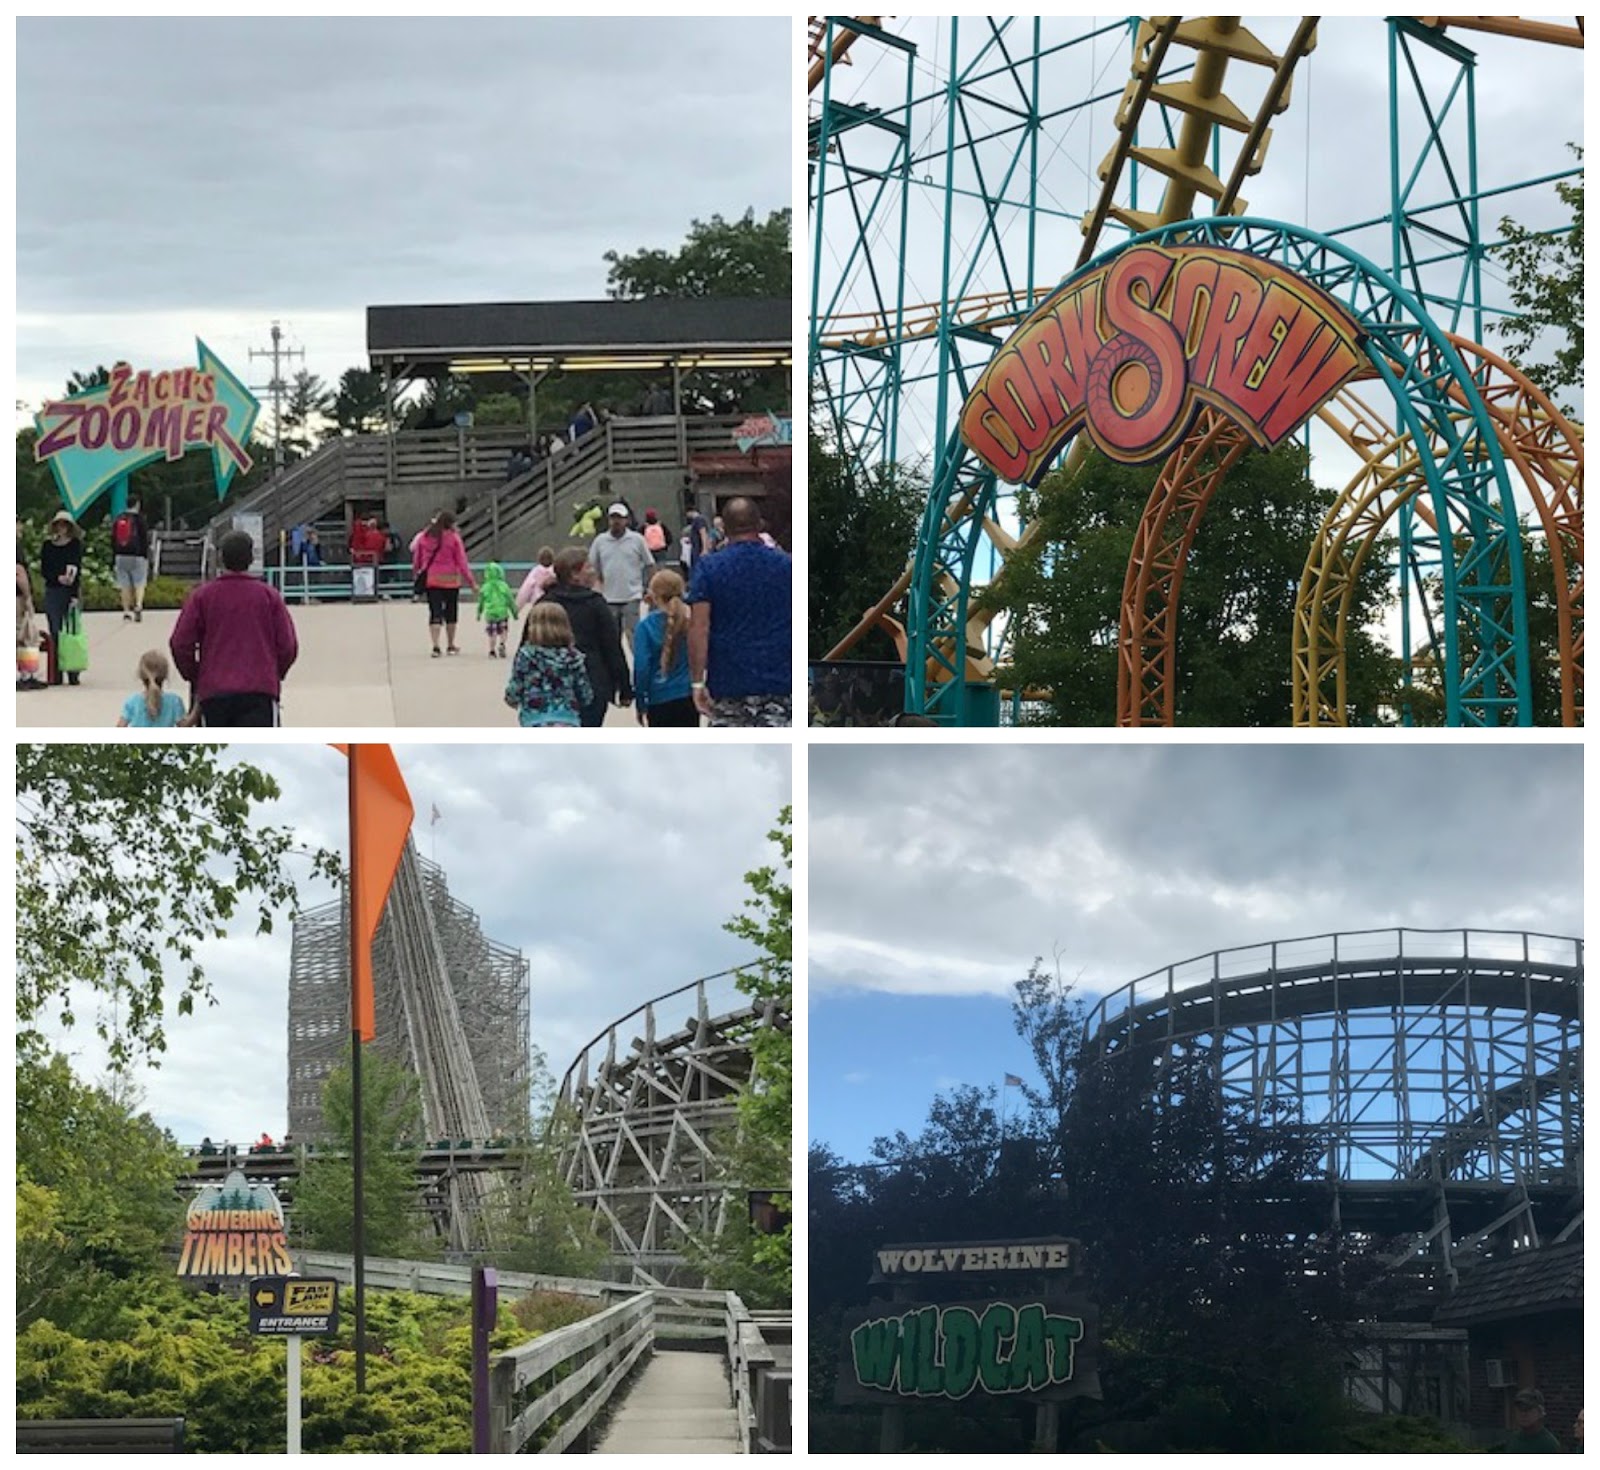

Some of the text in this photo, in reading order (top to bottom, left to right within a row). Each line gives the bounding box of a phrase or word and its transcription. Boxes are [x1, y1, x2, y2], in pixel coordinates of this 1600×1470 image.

[110, 363, 215, 405] ZACH'S
[961, 246, 1361, 484] CORKSCREW
[36, 402, 252, 474] ZOOMER
[188, 1210, 280, 1230] SHIVERING
[177, 1232, 293, 1275] TIMBERS
[877, 1244, 1070, 1273] WOLVERINE
[259, 1317, 328, 1327] ENTRANCE
[851, 1302, 1084, 1400] WILDCAT
